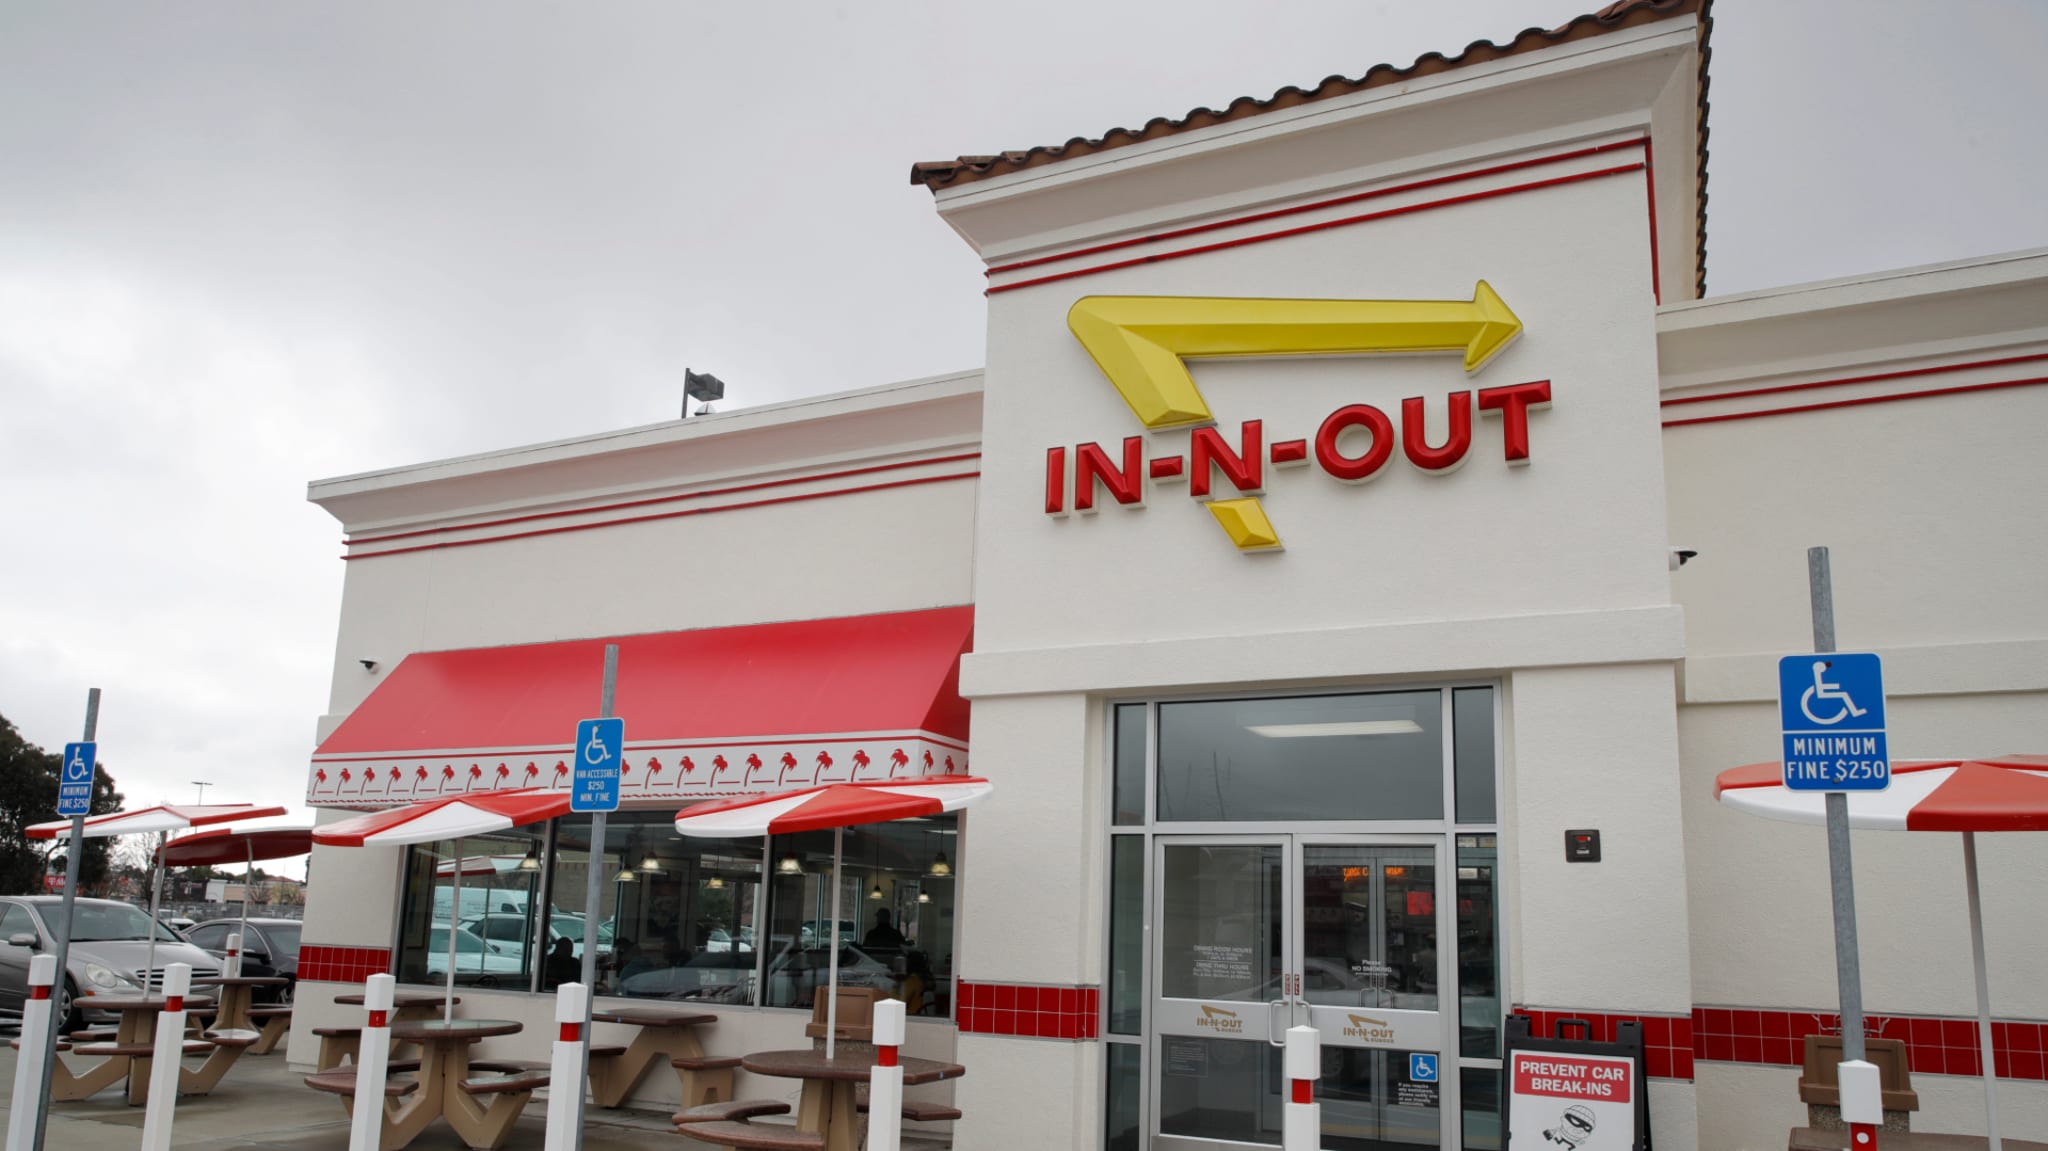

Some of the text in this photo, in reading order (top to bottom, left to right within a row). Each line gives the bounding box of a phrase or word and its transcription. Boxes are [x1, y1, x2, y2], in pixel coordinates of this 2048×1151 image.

[1045, 380, 1552, 517] IN-N-OUT
[1793, 737, 1877, 756] MINIMUM
[576, 768, 619, 779] VAN ACCESSIBLE
[1787, 758, 1886, 781] FINE $250
[62, 786, 89, 797] MINIMUM
[587, 780, 605, 791] $250
[59, 798, 90, 809] FINE $250
[595, 792, 610, 802] FINE
[1520, 1061, 1624, 1081] PREVENT CAR
[1531, 1077, 1612, 1096] BREAK-INS
